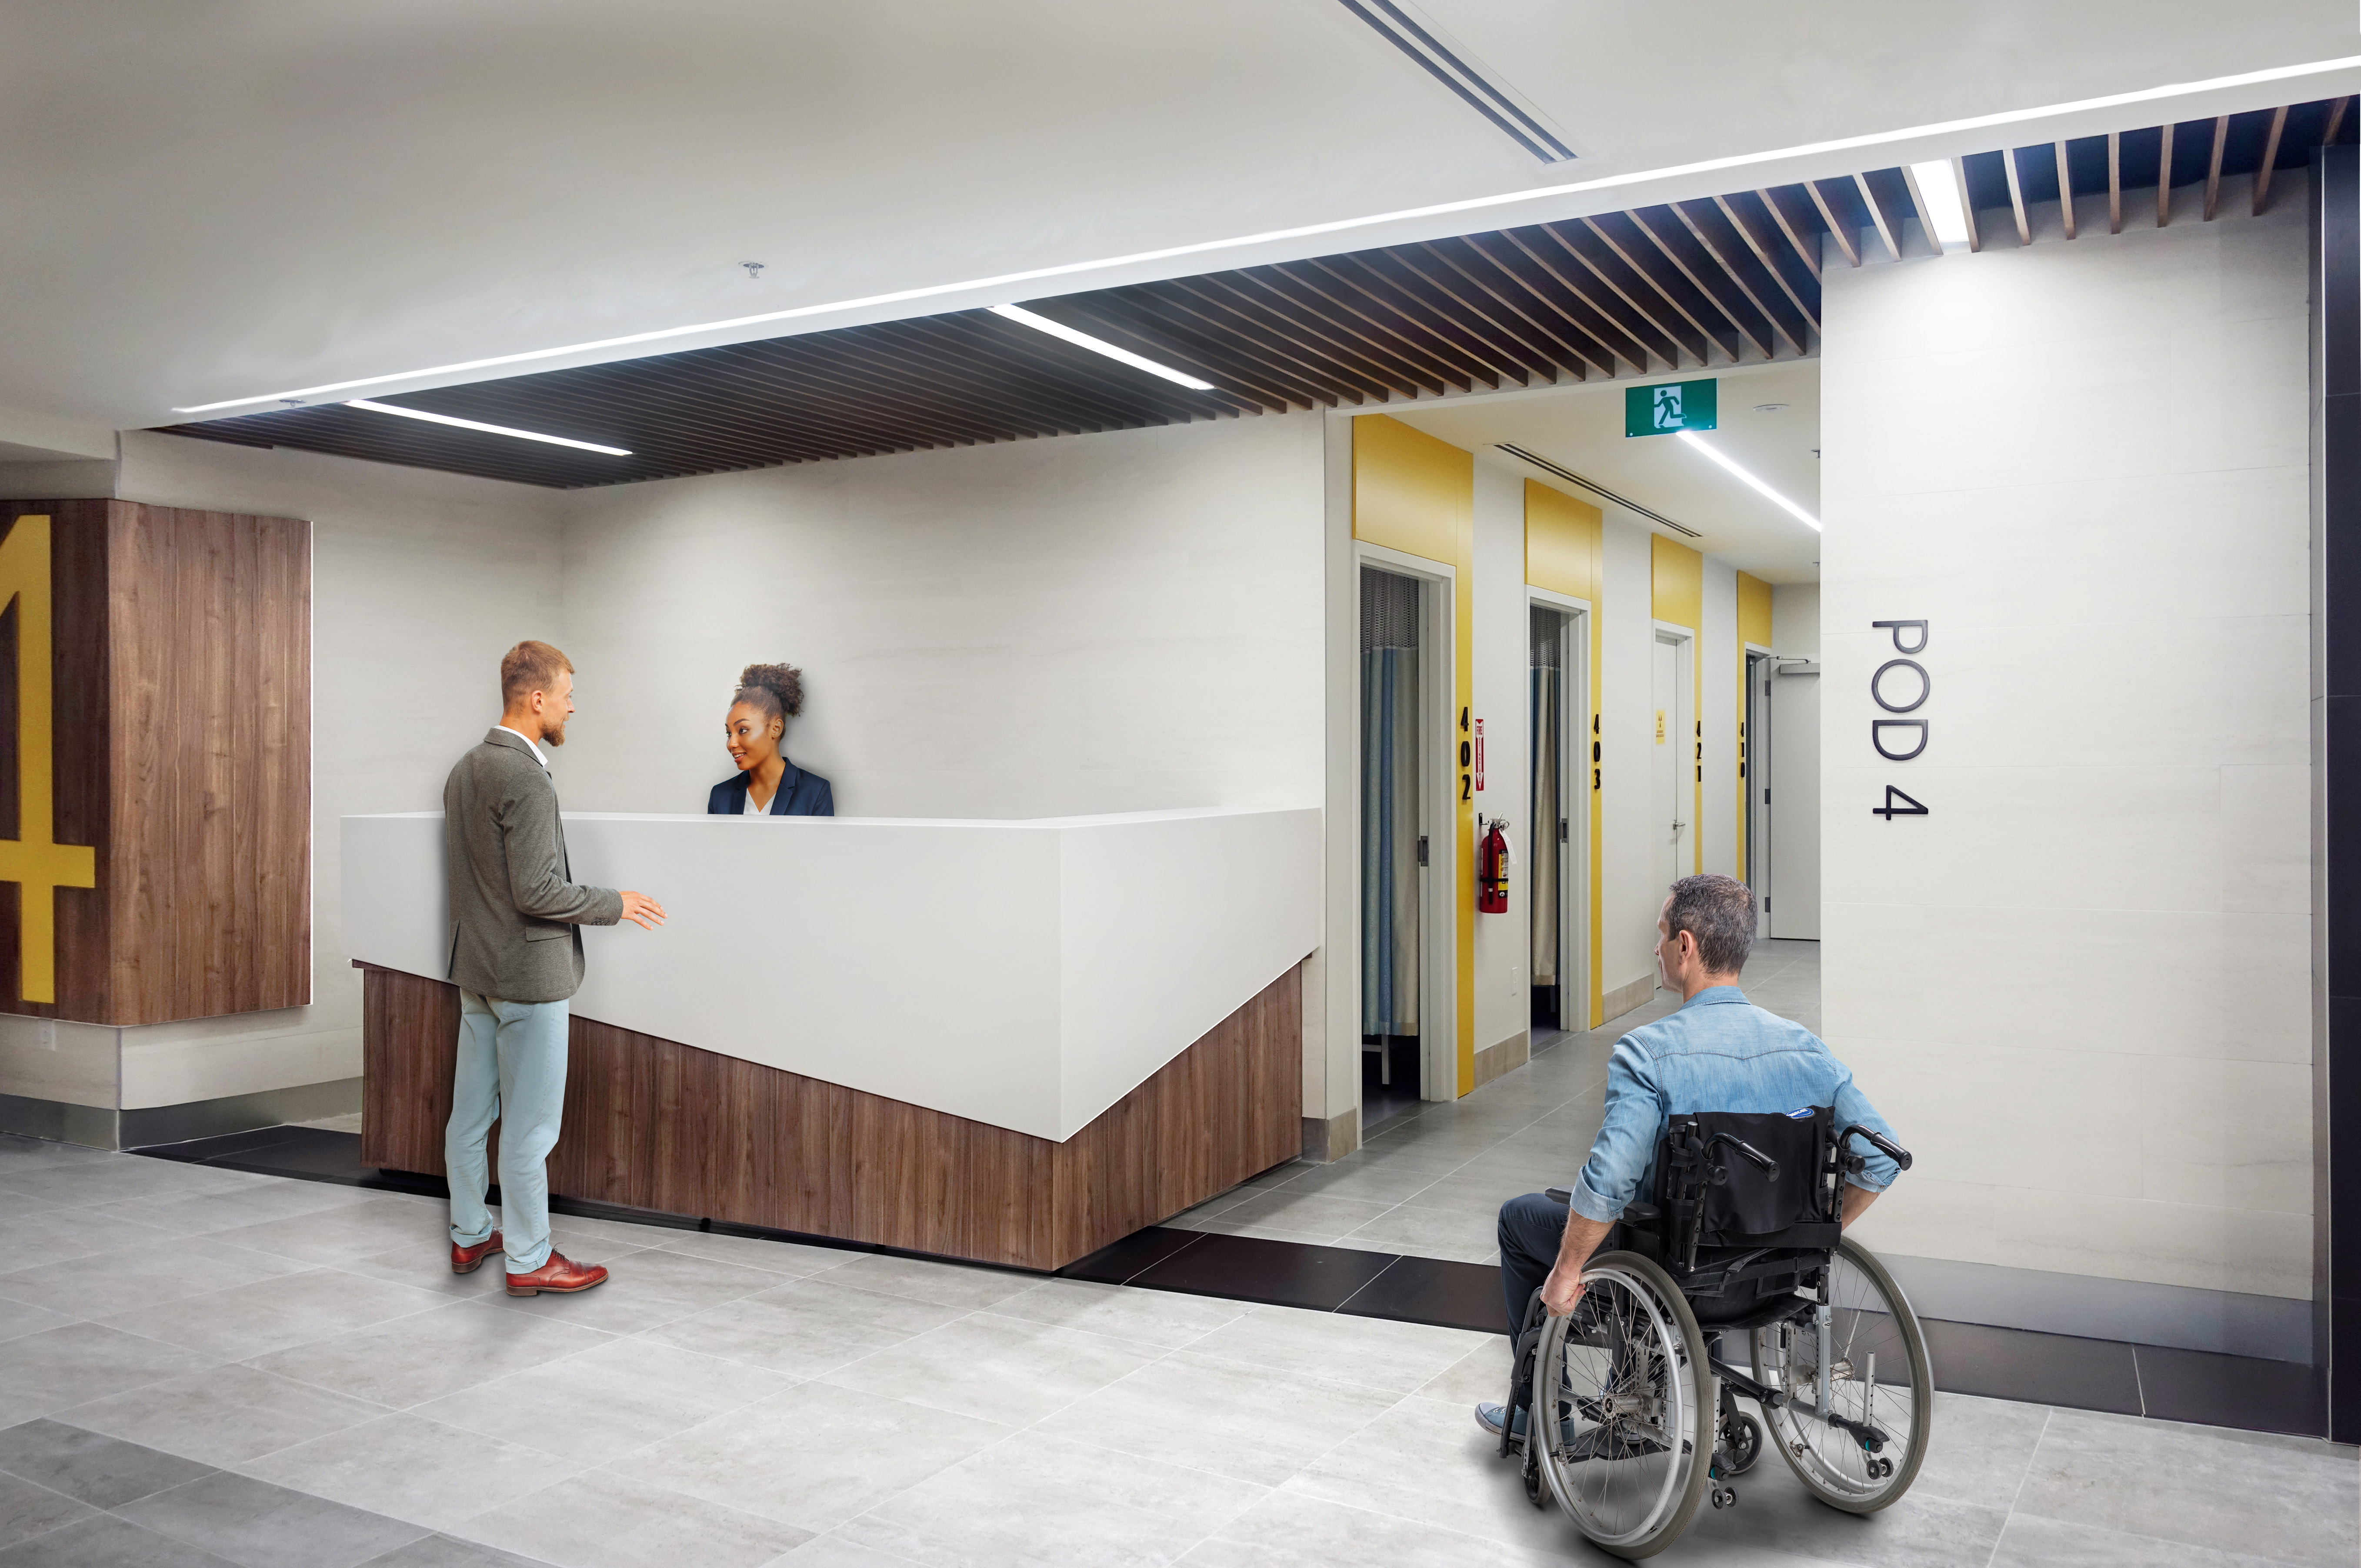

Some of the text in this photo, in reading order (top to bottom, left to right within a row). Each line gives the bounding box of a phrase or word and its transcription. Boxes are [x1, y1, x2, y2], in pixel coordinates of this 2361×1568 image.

[0, 515, 95, 1004] 4
[1461, 707, 1471, 800] 402
[1872, 620, 1930, 820] POD 4
